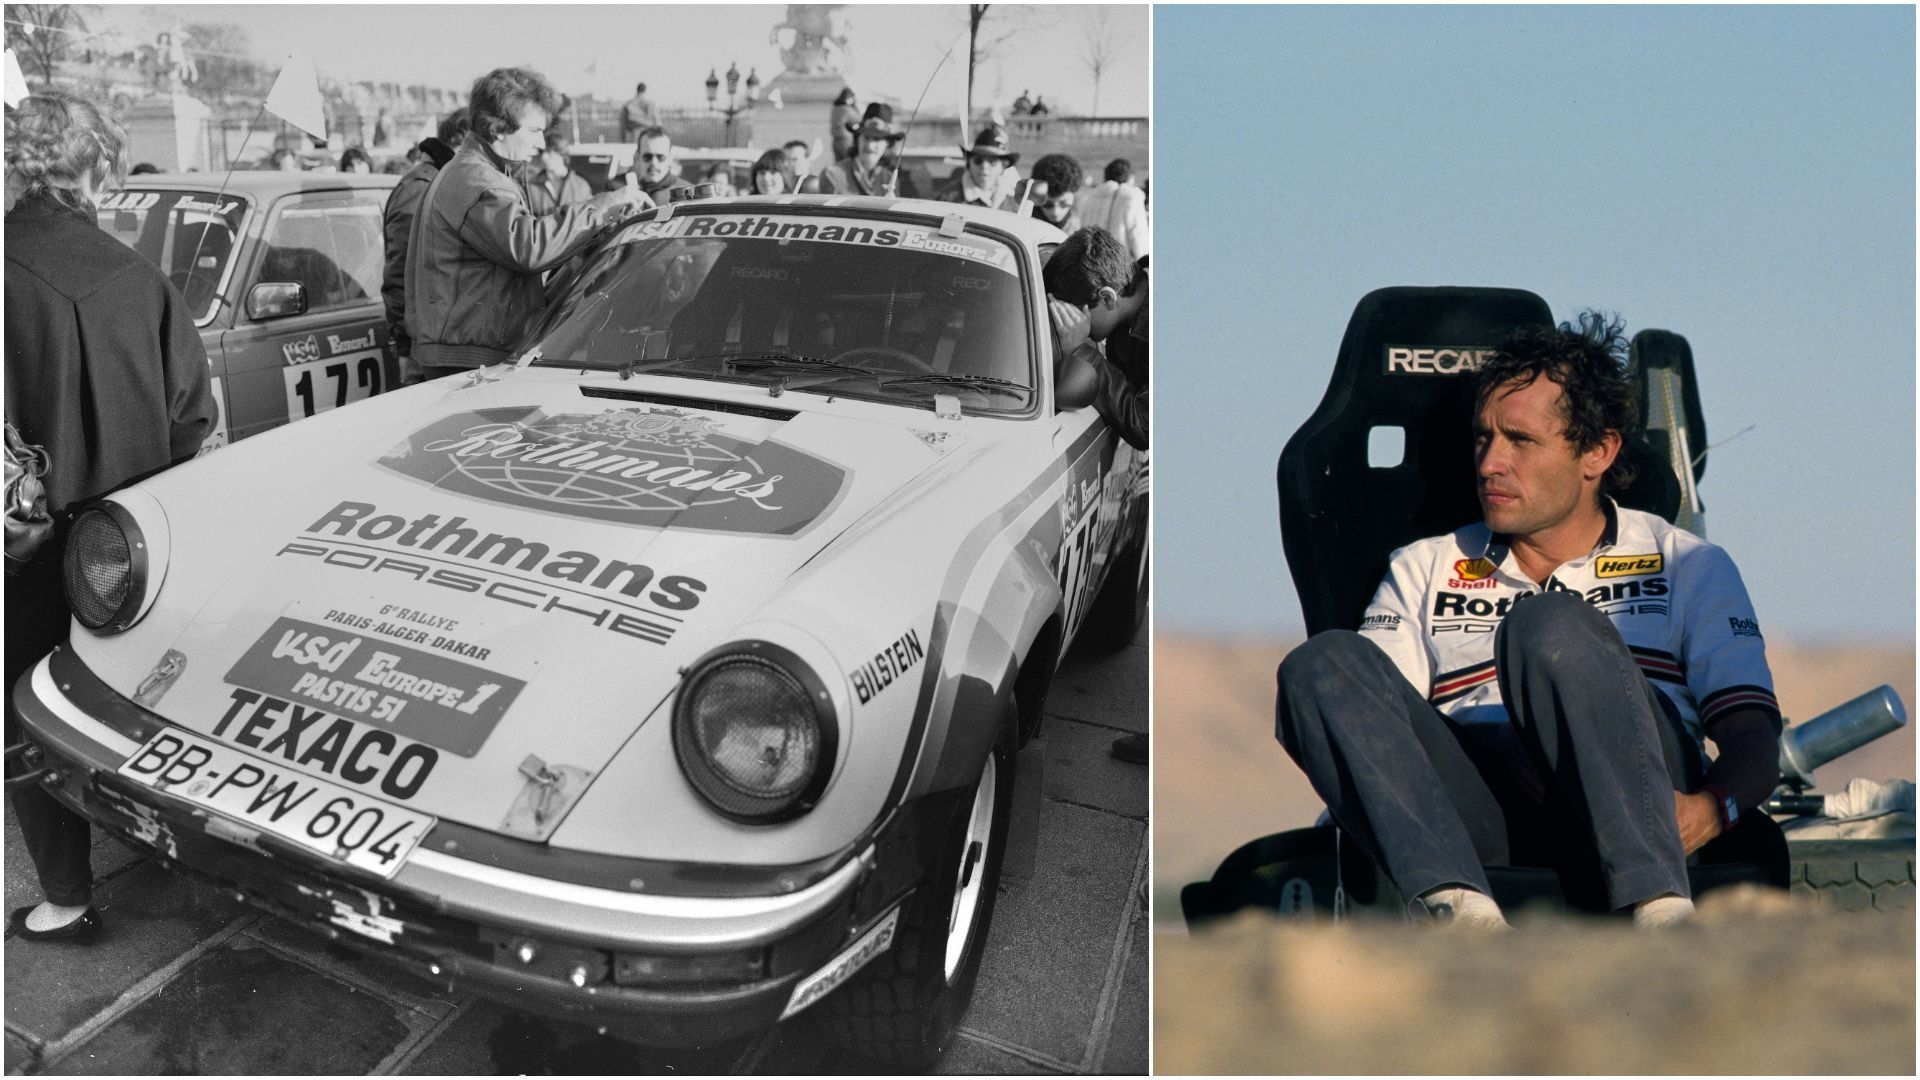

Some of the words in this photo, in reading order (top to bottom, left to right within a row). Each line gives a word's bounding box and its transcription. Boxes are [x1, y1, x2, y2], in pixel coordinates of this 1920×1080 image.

[685, 216, 900, 246] Rothmans
[731, 266, 789, 281] RECARO
[1388, 347, 1497, 374] RECAR
[424, 422, 784, 511] Rothmans
[305, 500, 708, 611] Rothmans
[1600, 558, 1660, 573] Hertz
[275, 542, 679, 647] PORSCHE
[1447, 578, 1498, 590] Shell
[323, 609, 491, 661] PARIS-ALGER-DAKAR
[397, 607, 460, 632] RALLYE
[848, 627, 924, 706] BILSTEIN
[291, 671, 378, 717] PASTIS
[370, 696, 407, 723] 51
[211, 687, 440, 801] TEXACO
[305, 796, 415, 866] 604
